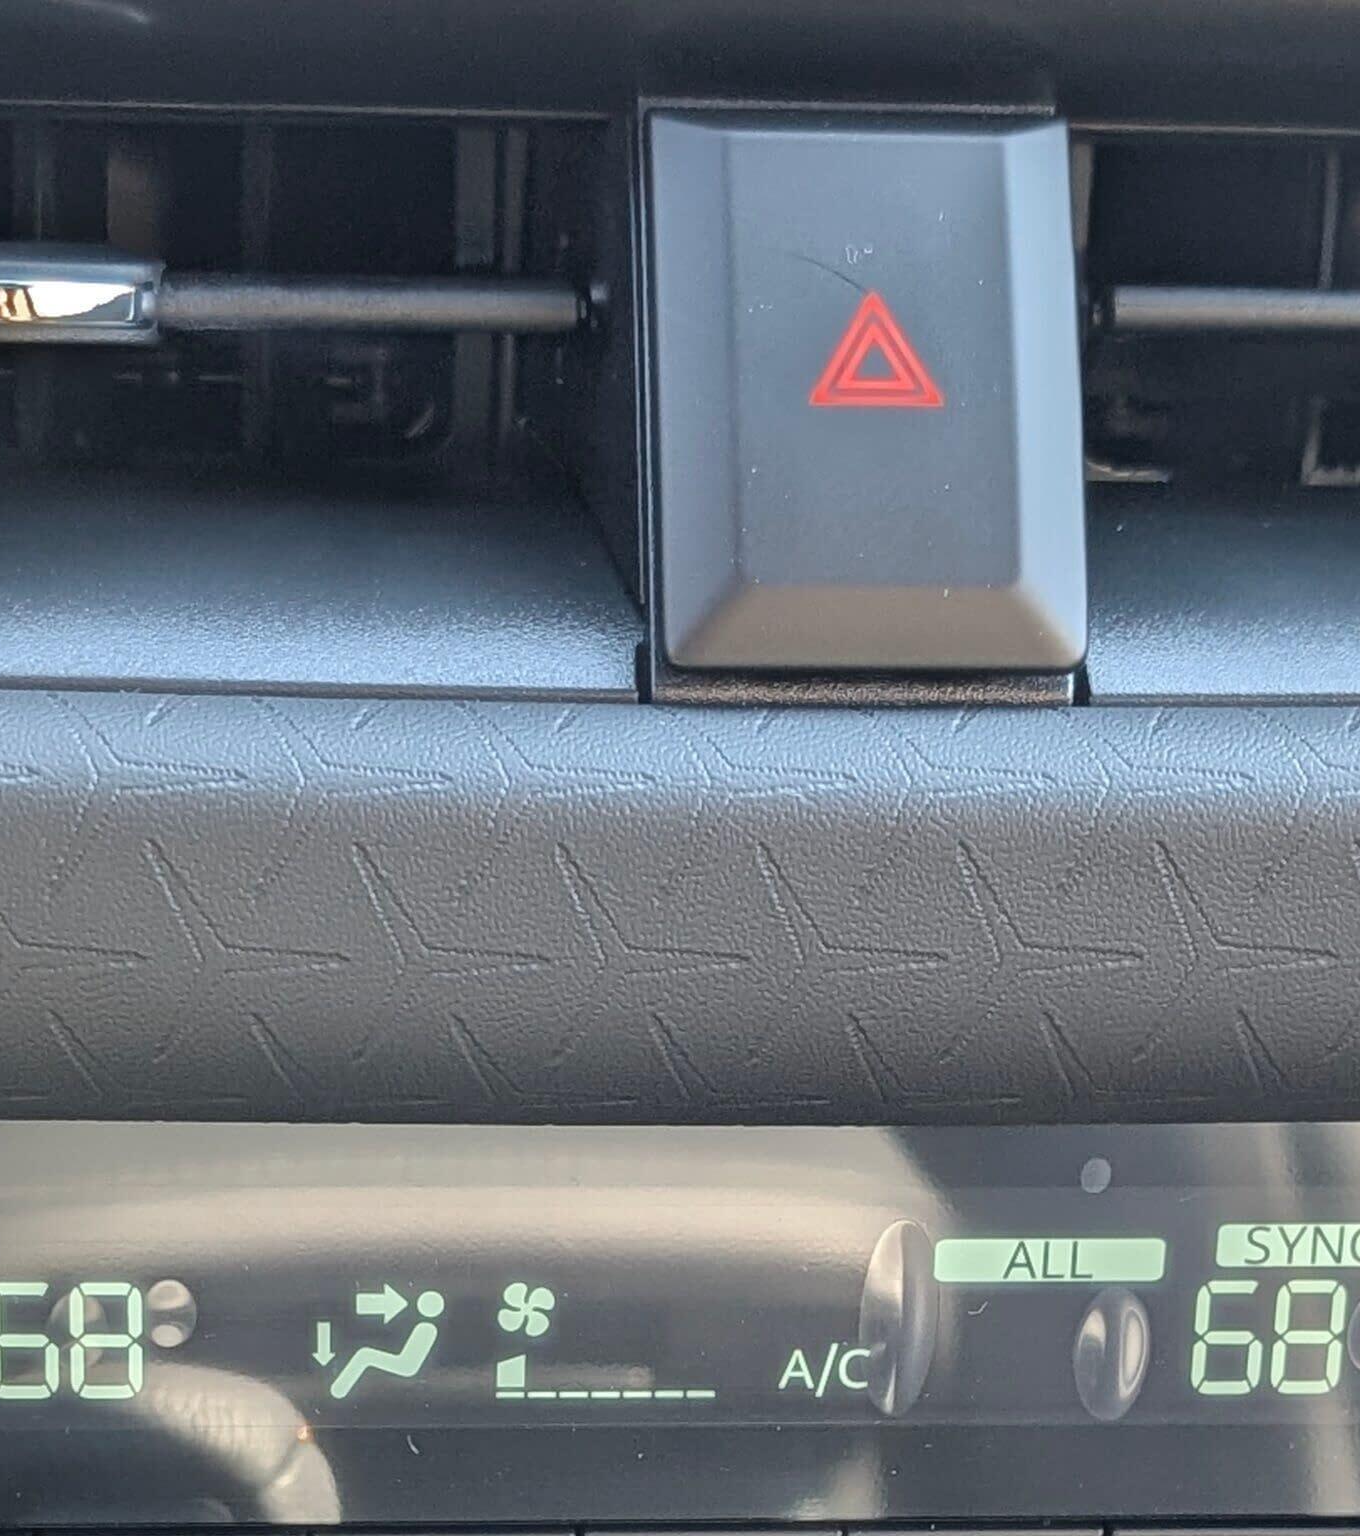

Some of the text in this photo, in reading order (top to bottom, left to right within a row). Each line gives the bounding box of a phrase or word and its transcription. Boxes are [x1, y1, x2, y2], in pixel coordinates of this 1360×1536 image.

[1001, 1241, 1094, 1280] ALL
[1189, 1279, 1348, 1395] 68
[777, 1344, 872, 1398] A/C
